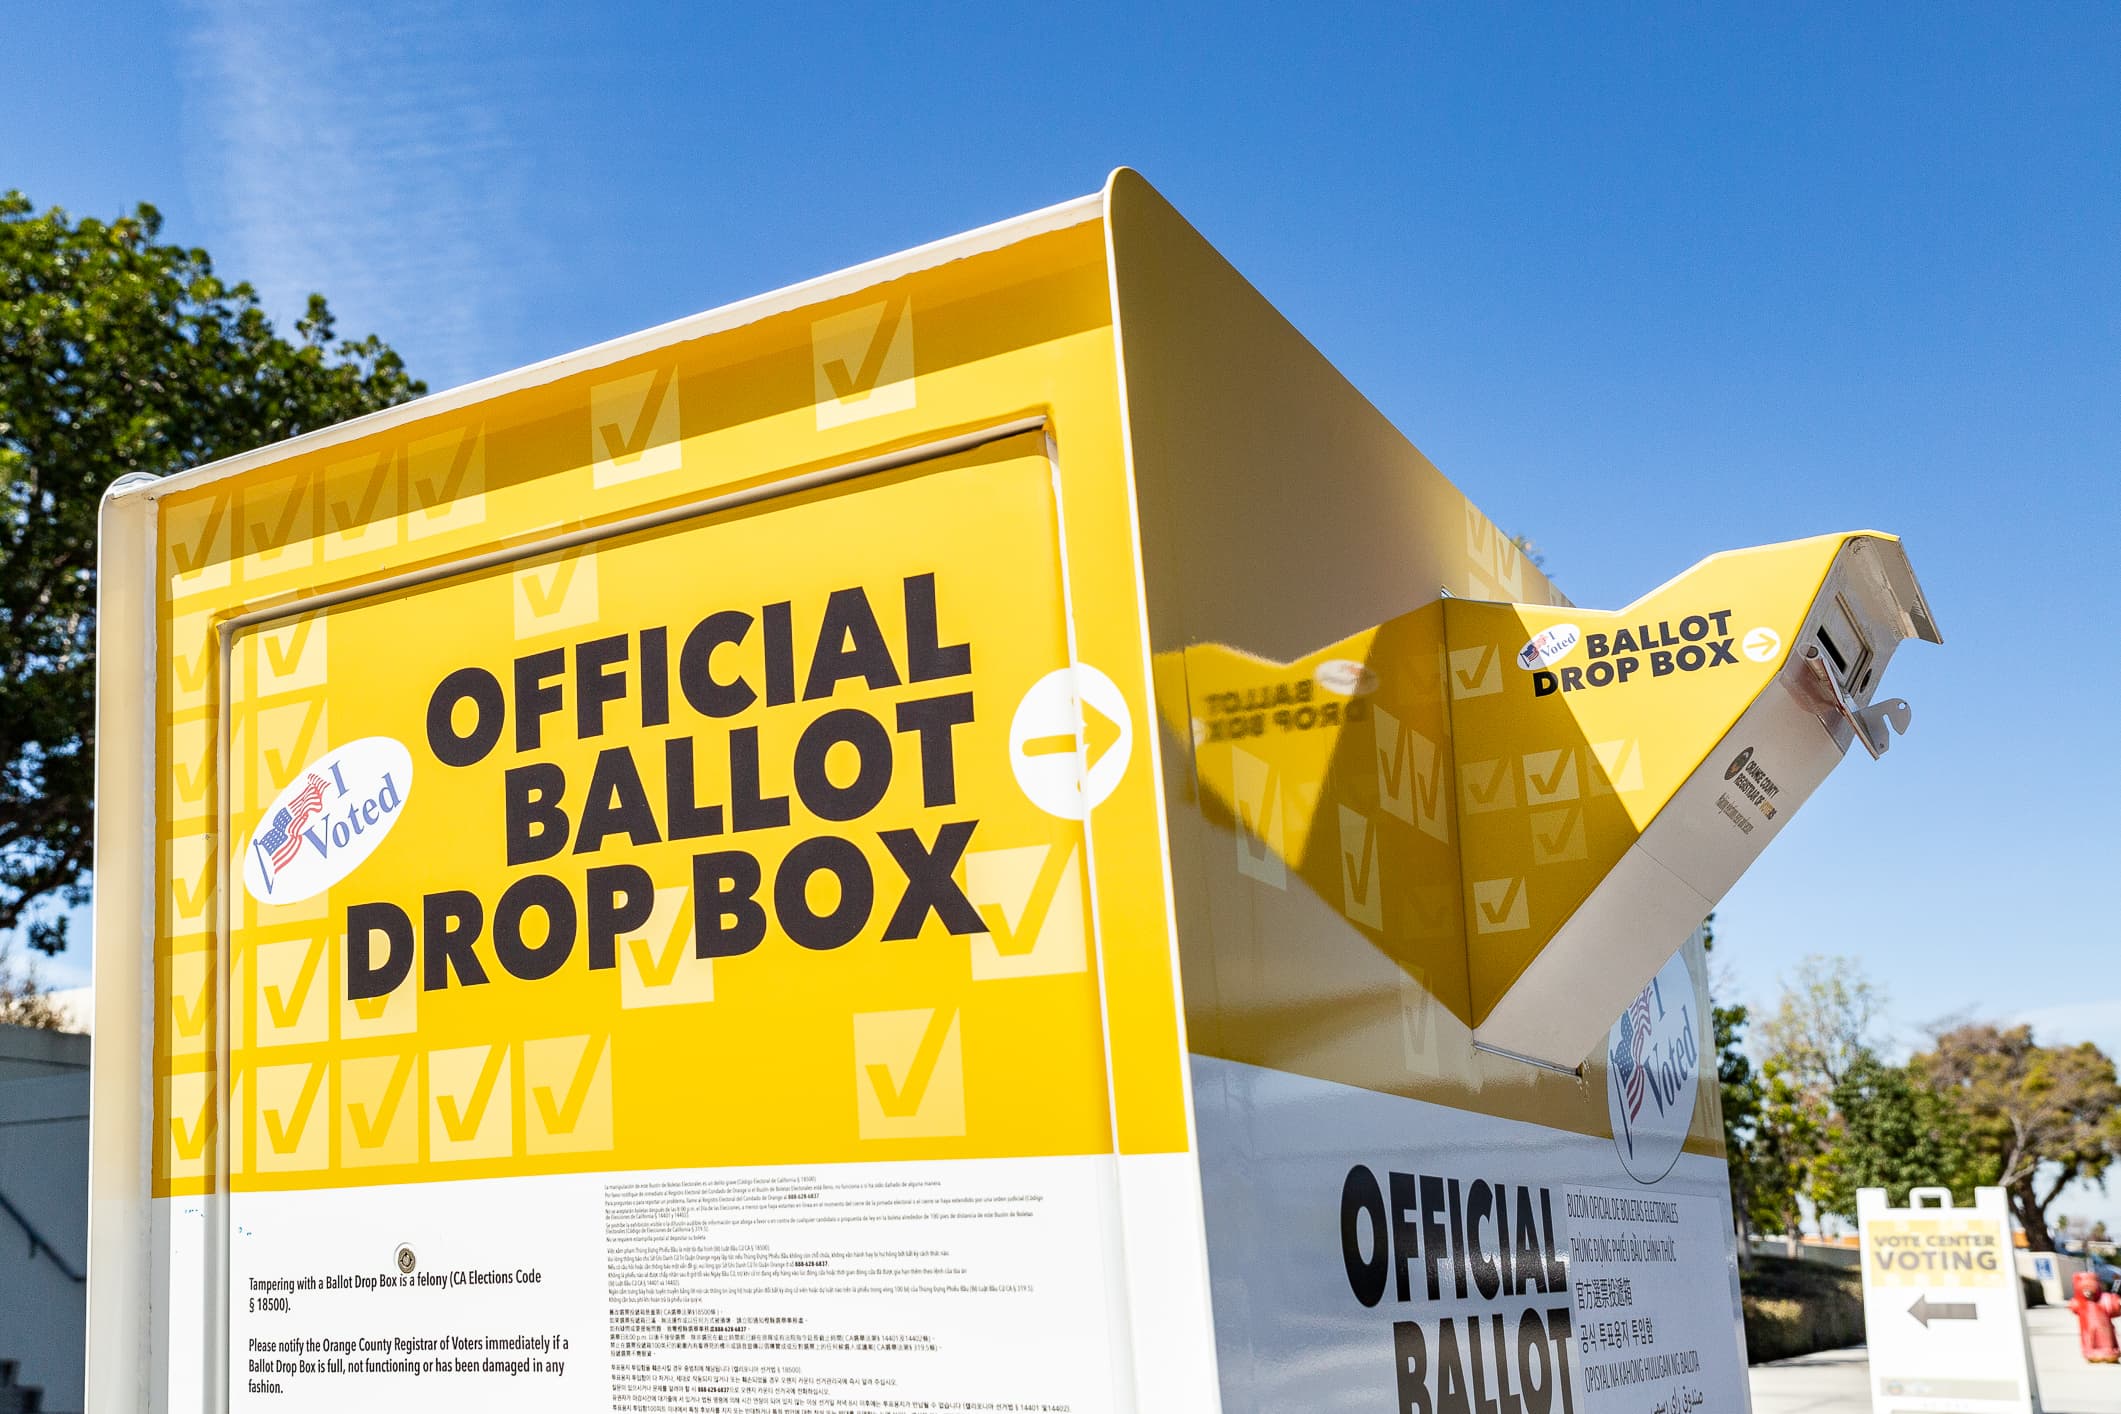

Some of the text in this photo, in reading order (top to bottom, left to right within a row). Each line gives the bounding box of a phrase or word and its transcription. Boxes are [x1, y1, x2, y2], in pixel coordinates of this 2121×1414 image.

[1540, 632, 1576, 657] Voted
[1586, 609, 1732, 659] BALLOT
[426, 572, 972, 767] OFFICIAL
[1533, 638, 1739, 697] DROP BOX
[328, 760, 350, 798] I
[504, 691, 975, 867] BALLOT
[1760, 777, 1780, 799] COUNTY
[303, 772, 401, 859] Voted
[347, 819, 989, 1001] DROP BOX
[1653, 976, 1665, 1021] I
[1644, 1004, 1697, 1118] Voted
[1567, 1189, 1679, 1223] BUZÓN OFICIAL DE BOLETAS ELECTORALES
[1341, 1164, 1568, 1308] OFFICIAL
[1874, 1235, 1995, 1248] VOTE CENTER
[1875, 1250, 1998, 1271] VOTING
[248, 1268, 542, 1294] Tampering with a Ballot Drop Box is a felony (CA Elections Code
[1576, 1277, 1632, 1310] 官方選票投遞箱
[250, 1298, 290, 1314] § 18500).
[248, 1334, 568, 1356] Please notify the Orange County Registrar of Voters immediately if a
[1580, 1317, 1654, 1353] 공식 투표용지 투입함
[248, 1358, 564, 1376] Ballot Drop Box is full, not functioning or has been damaged in any
[1393, 1308, 1574, 1414] BALLOT
[1584, 1363, 1611, 1393] OPISYAL
[1610, 1361, 1619, 1388] NA
[1619, 1358, 1644, 1386] KAHONG
[1671, 1352, 1680, 1376] NG
[1680, 1350, 1700, 1374] BALOTA
[248, 1378, 284, 1394] fashion.
